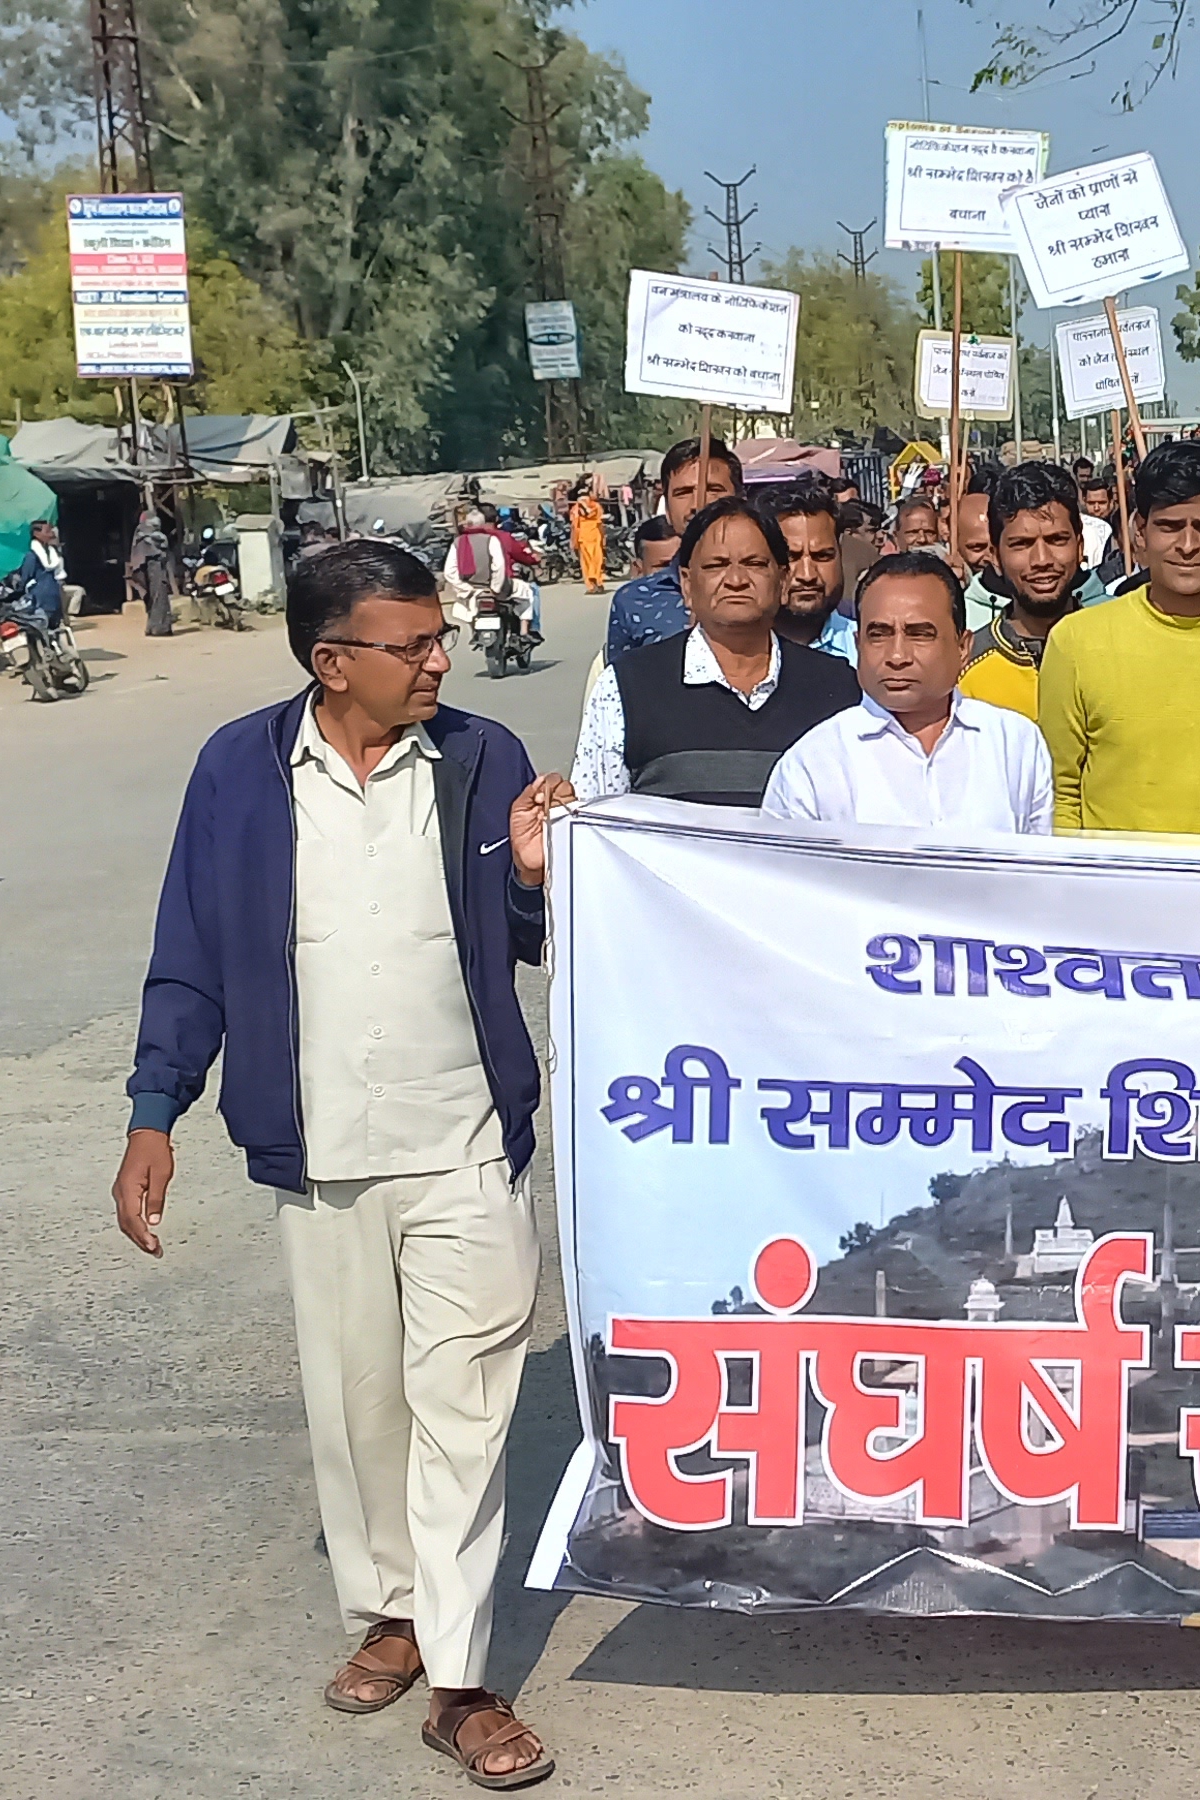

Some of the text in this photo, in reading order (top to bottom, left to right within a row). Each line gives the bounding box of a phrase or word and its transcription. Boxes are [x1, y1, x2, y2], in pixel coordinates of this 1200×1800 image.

[907, 165, 923, 178] श्री
[1006, 169, 1023, 184] को
[1066, 184, 1087, 200] को
[1089, 173, 1121, 197] प्राणों
[1121, 168, 1139, 185] से
[1078, 203, 1112, 221] प्यारा
[1047, 215, 1159, 257] श्री सम्मेद शिखर
[1091, 247, 1131, 269] हमारा
[651, 285, 667, 296] वन
[711, 292, 722, 303] के
[678, 323, 692, 334] को
[647, 353, 661, 366] श्री
[698, 361, 731, 375] शिखर
[733, 365, 747, 378] को
[750, 371, 781, 384] बचाना
[1078, 354, 1091, 366] को
[600, 1044, 741, 1145] श्री
[757, 1056, 1083, 1154] सम्मेद
[606, 1233, 1154, 1531] संघर्ष
